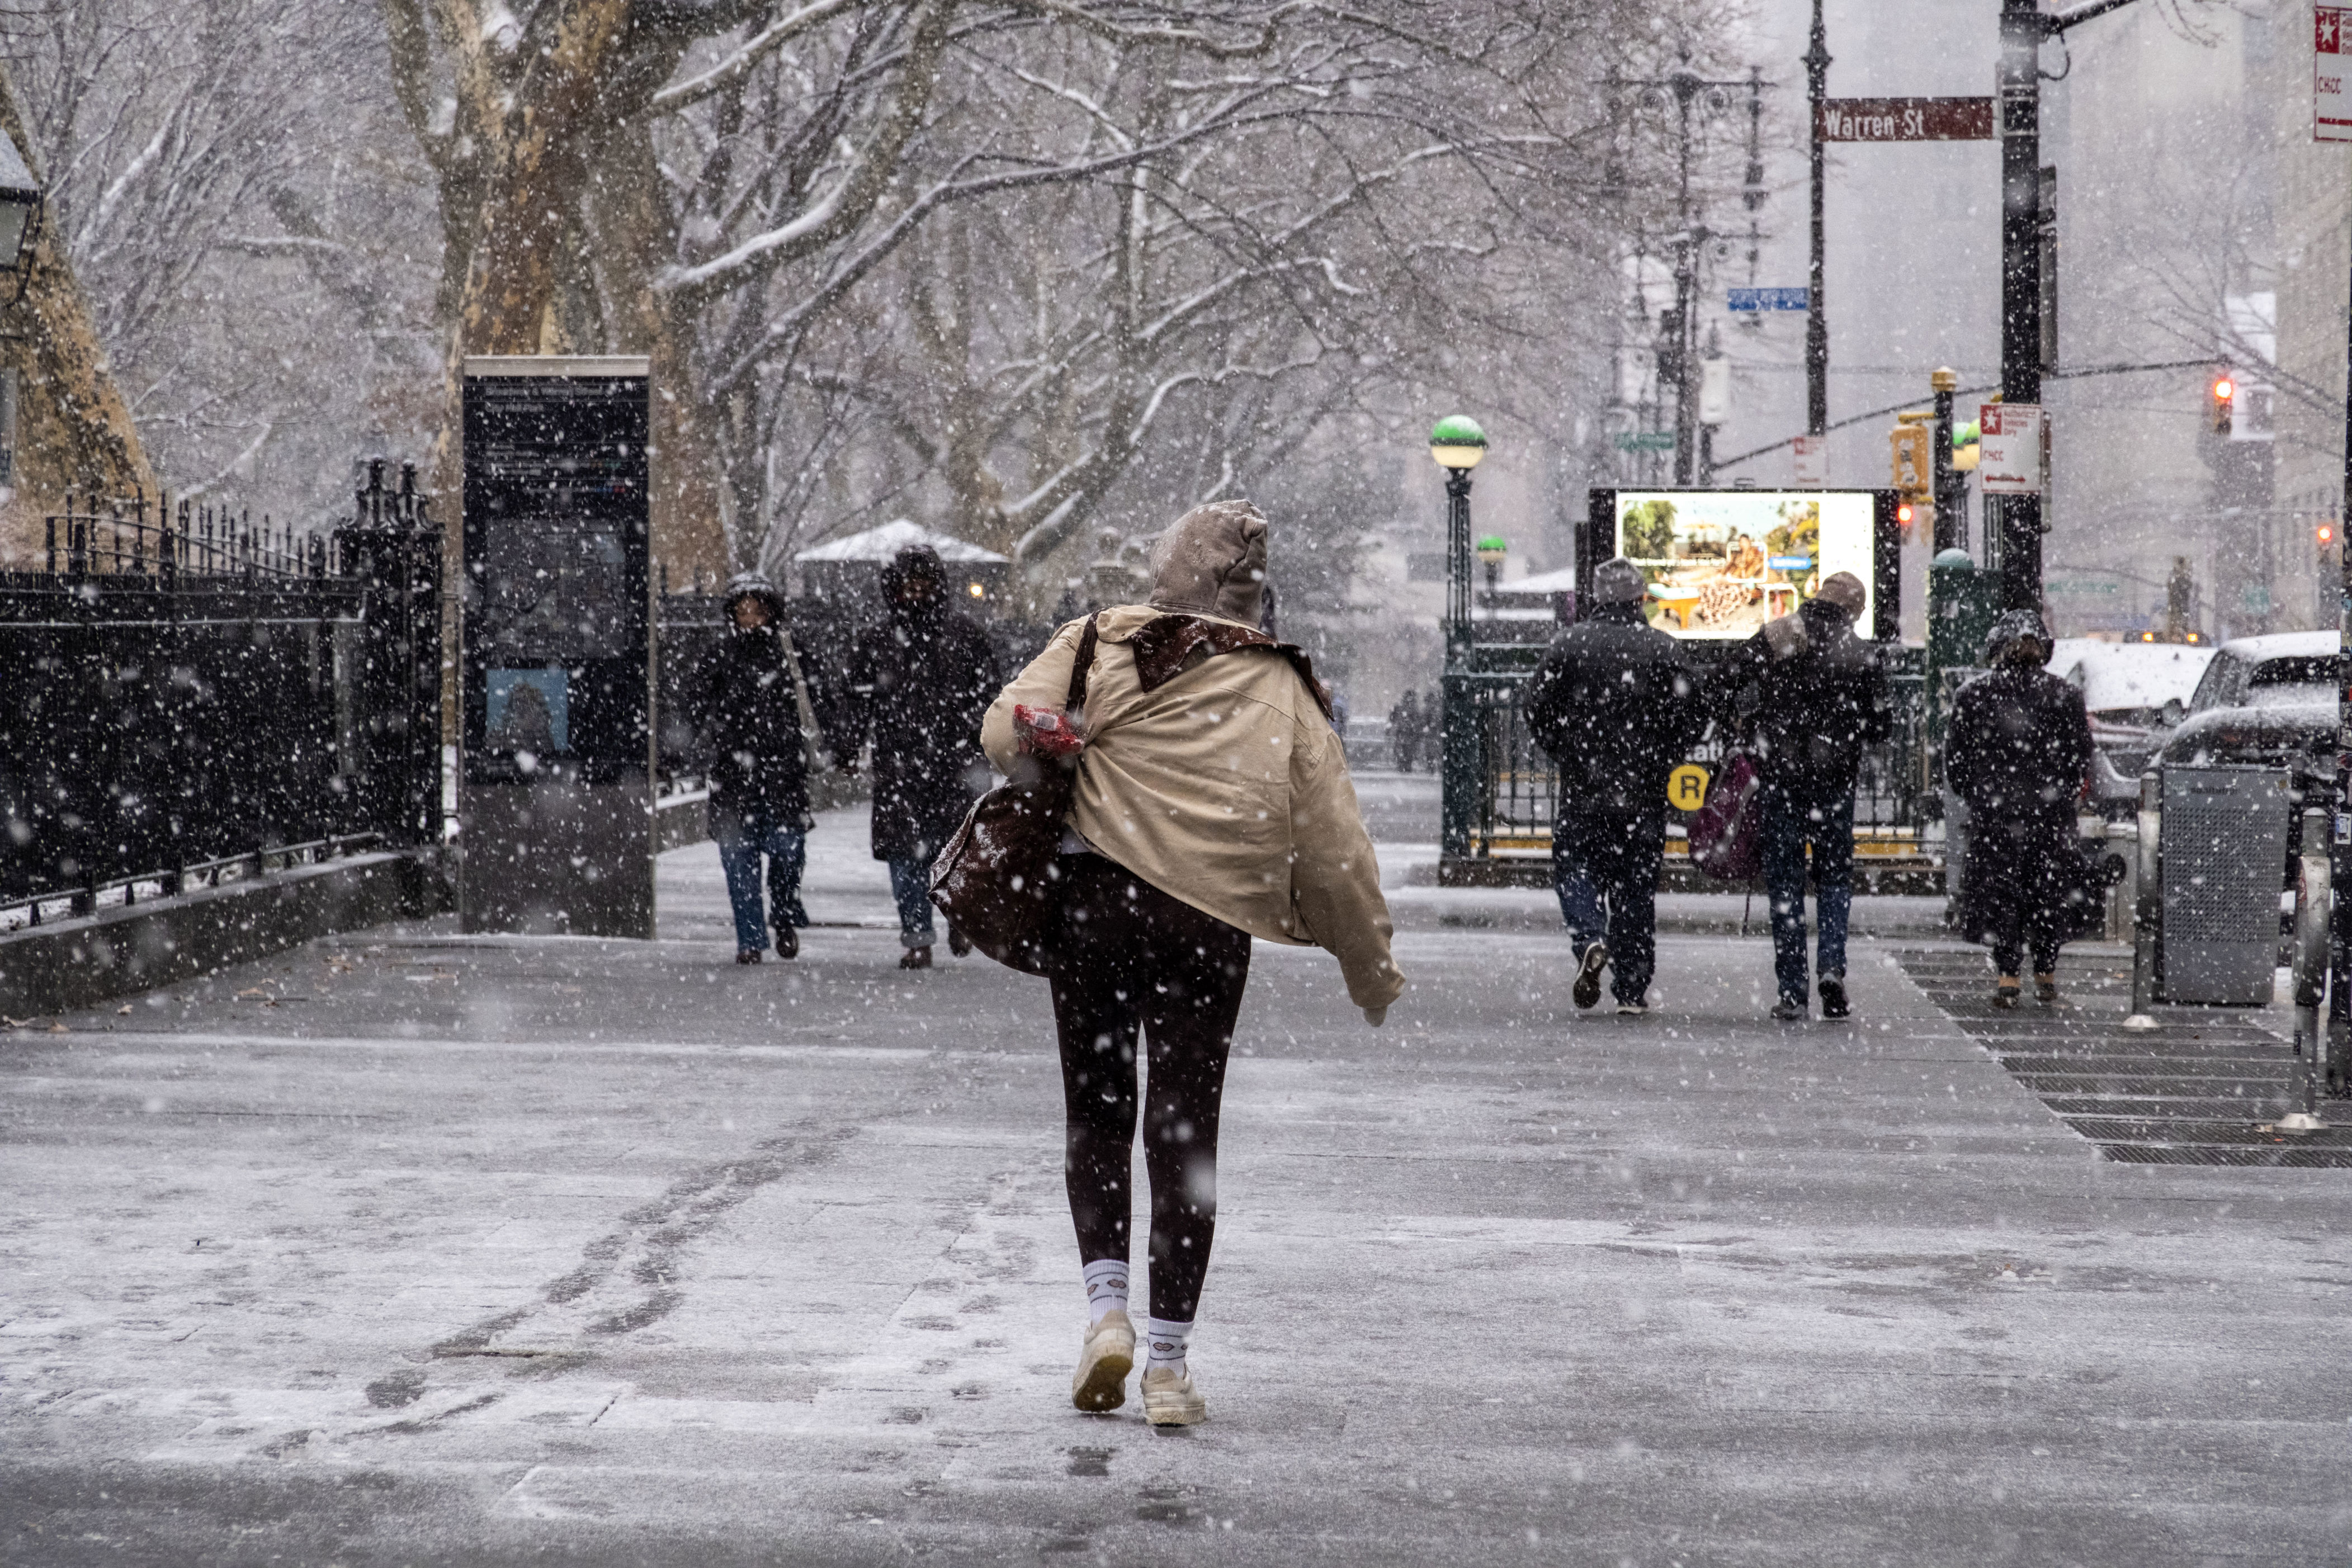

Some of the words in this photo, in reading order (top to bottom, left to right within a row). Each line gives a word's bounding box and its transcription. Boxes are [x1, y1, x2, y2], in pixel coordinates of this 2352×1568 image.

[1824, 109, 1895, 136] Warren
[1904, 109, 1924, 136] St
[1680, 775, 1700, 799] R
